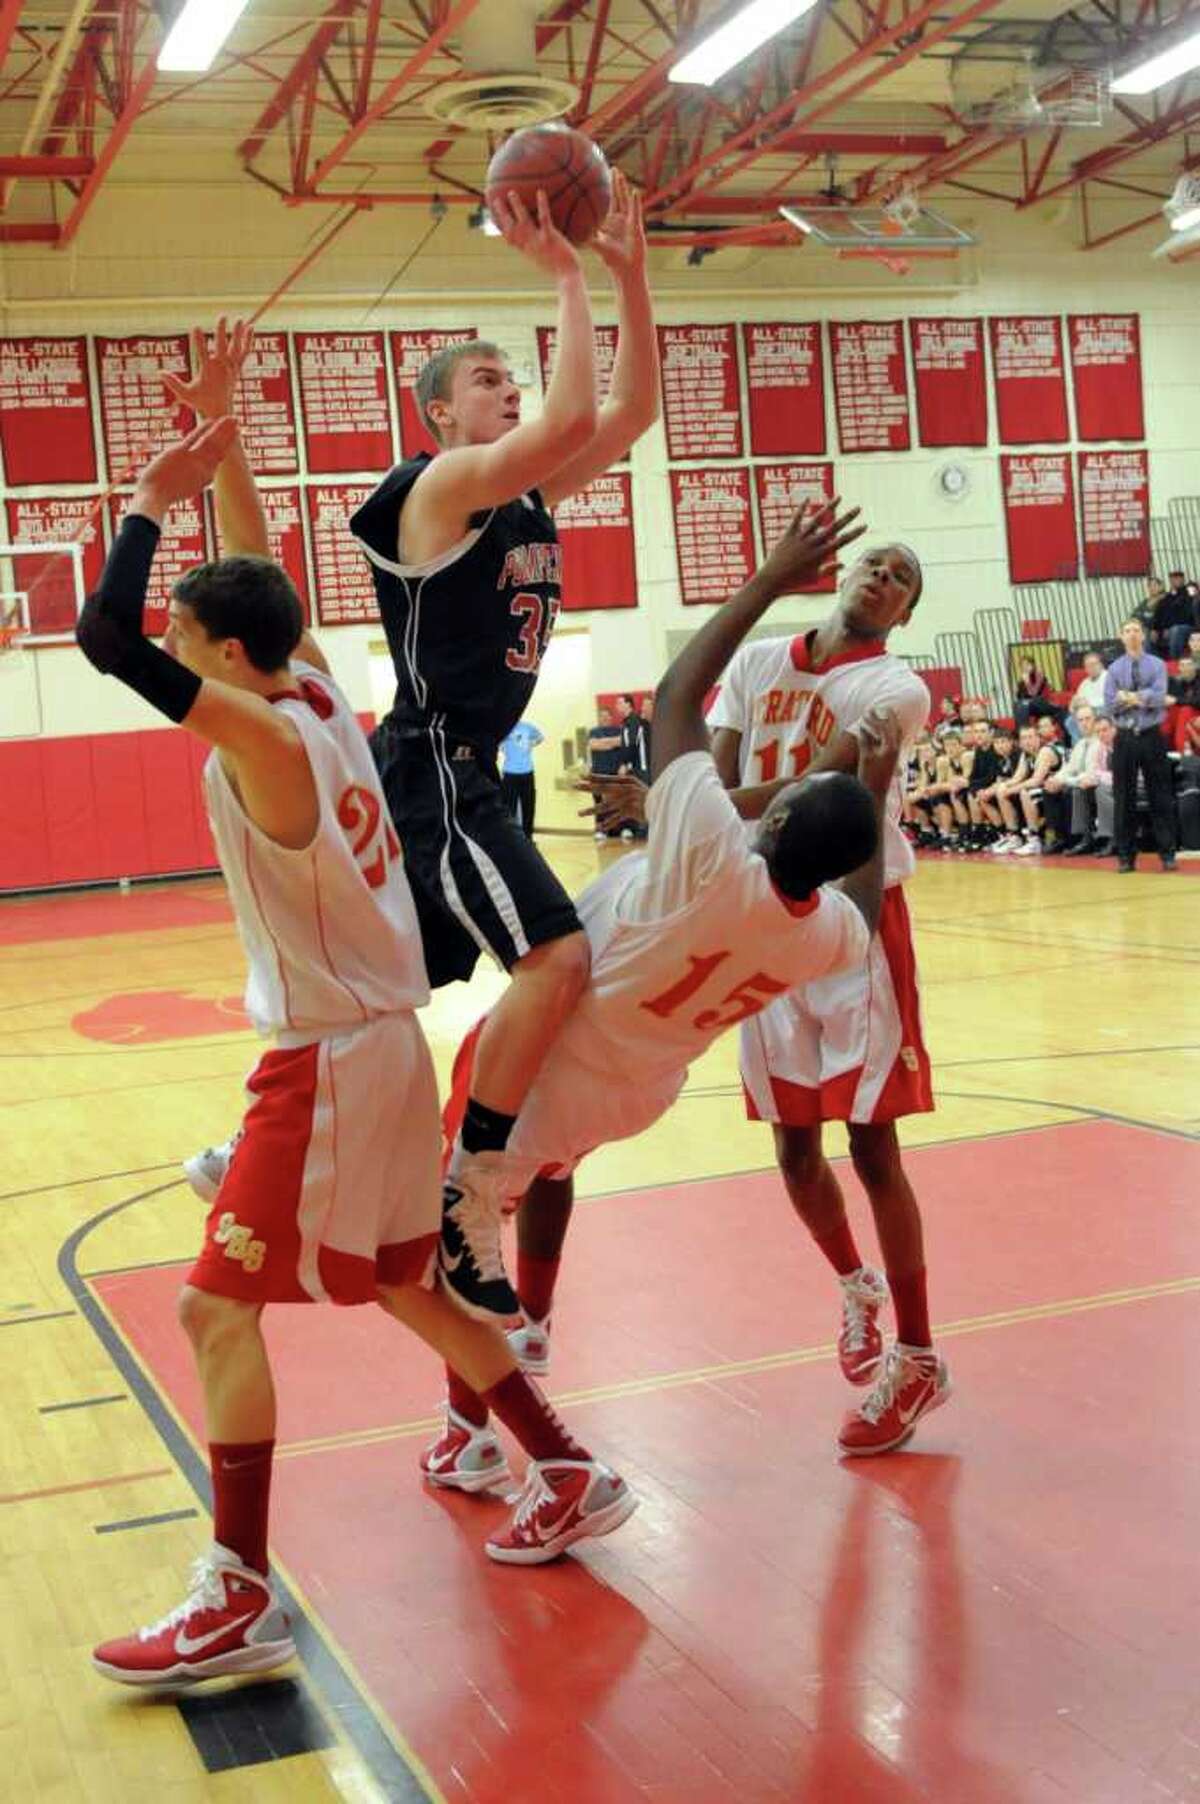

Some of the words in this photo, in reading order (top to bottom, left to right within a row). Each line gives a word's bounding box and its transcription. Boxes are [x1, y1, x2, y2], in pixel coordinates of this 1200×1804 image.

[663, 329, 729, 344] ALL-STATE
[752, 327, 812, 341] ALL-STATE
[1, 342, 79, 356] ALL-STATE
[105, 340, 179, 355] ALL-STATE
[304, 336, 375, 351] ALL-STATE
[678, 472, 742, 488] ALL-STATE
[764, 466, 824, 481] ALL-STATE
[17, 501, 94, 517] ALL-STATE
[639, 950, 792, 1031] 15
